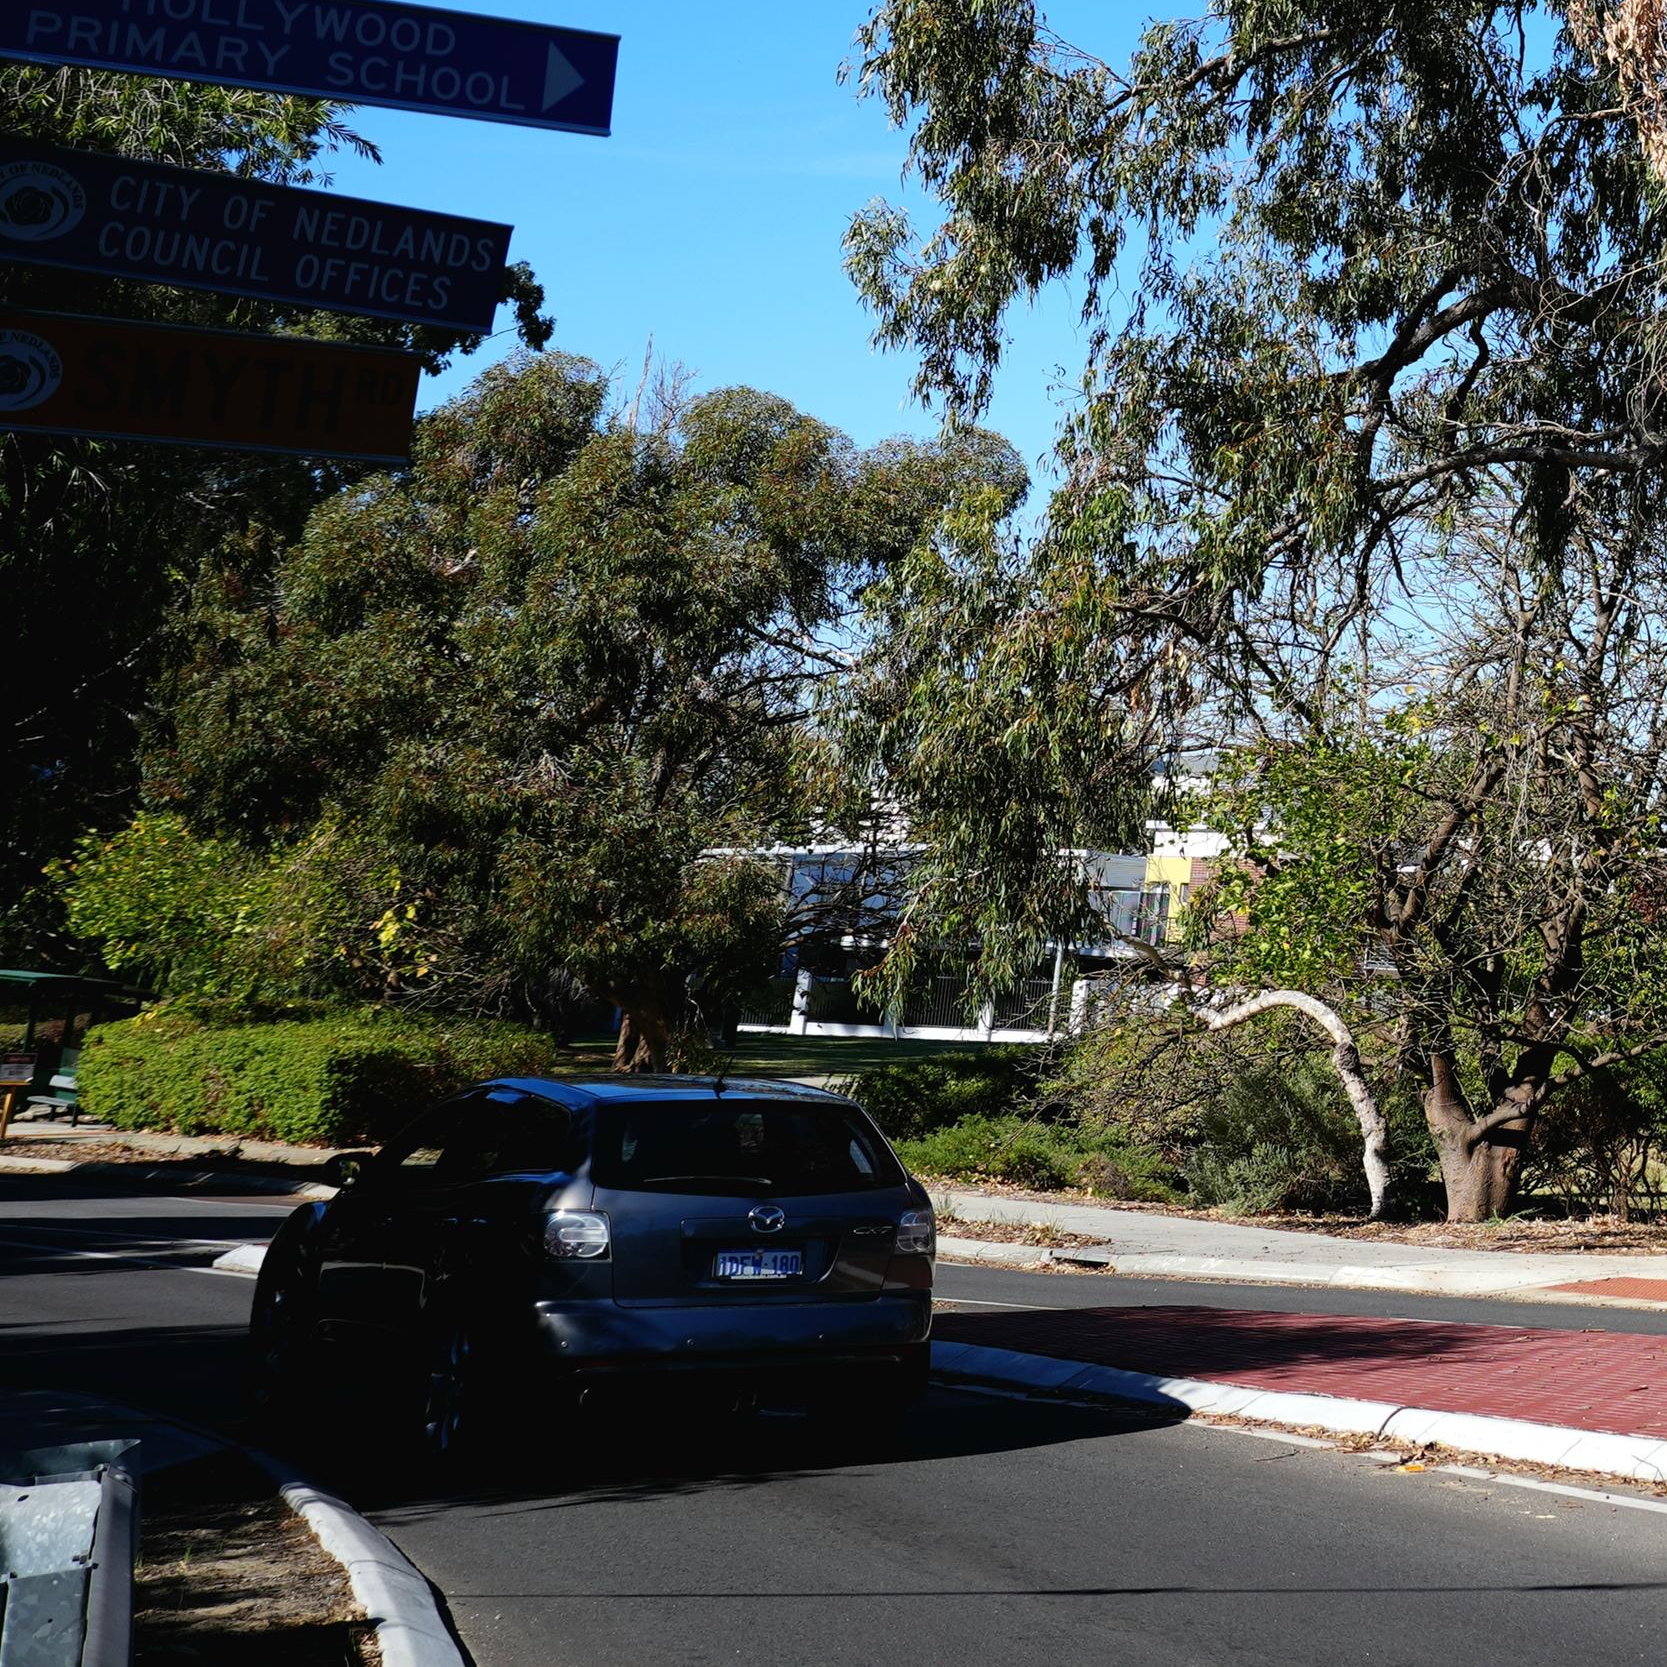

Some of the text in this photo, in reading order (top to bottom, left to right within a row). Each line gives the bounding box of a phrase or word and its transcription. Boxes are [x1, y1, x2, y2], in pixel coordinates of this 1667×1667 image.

[24, 9, 526, 111] PRIMARY SCHOOL
[97, 221, 453, 311] COUNCIL OFFICES
[109, 174, 496, 273] CITY OF NEDLANDS
[74, 341, 404, 435] SMYTH RD
